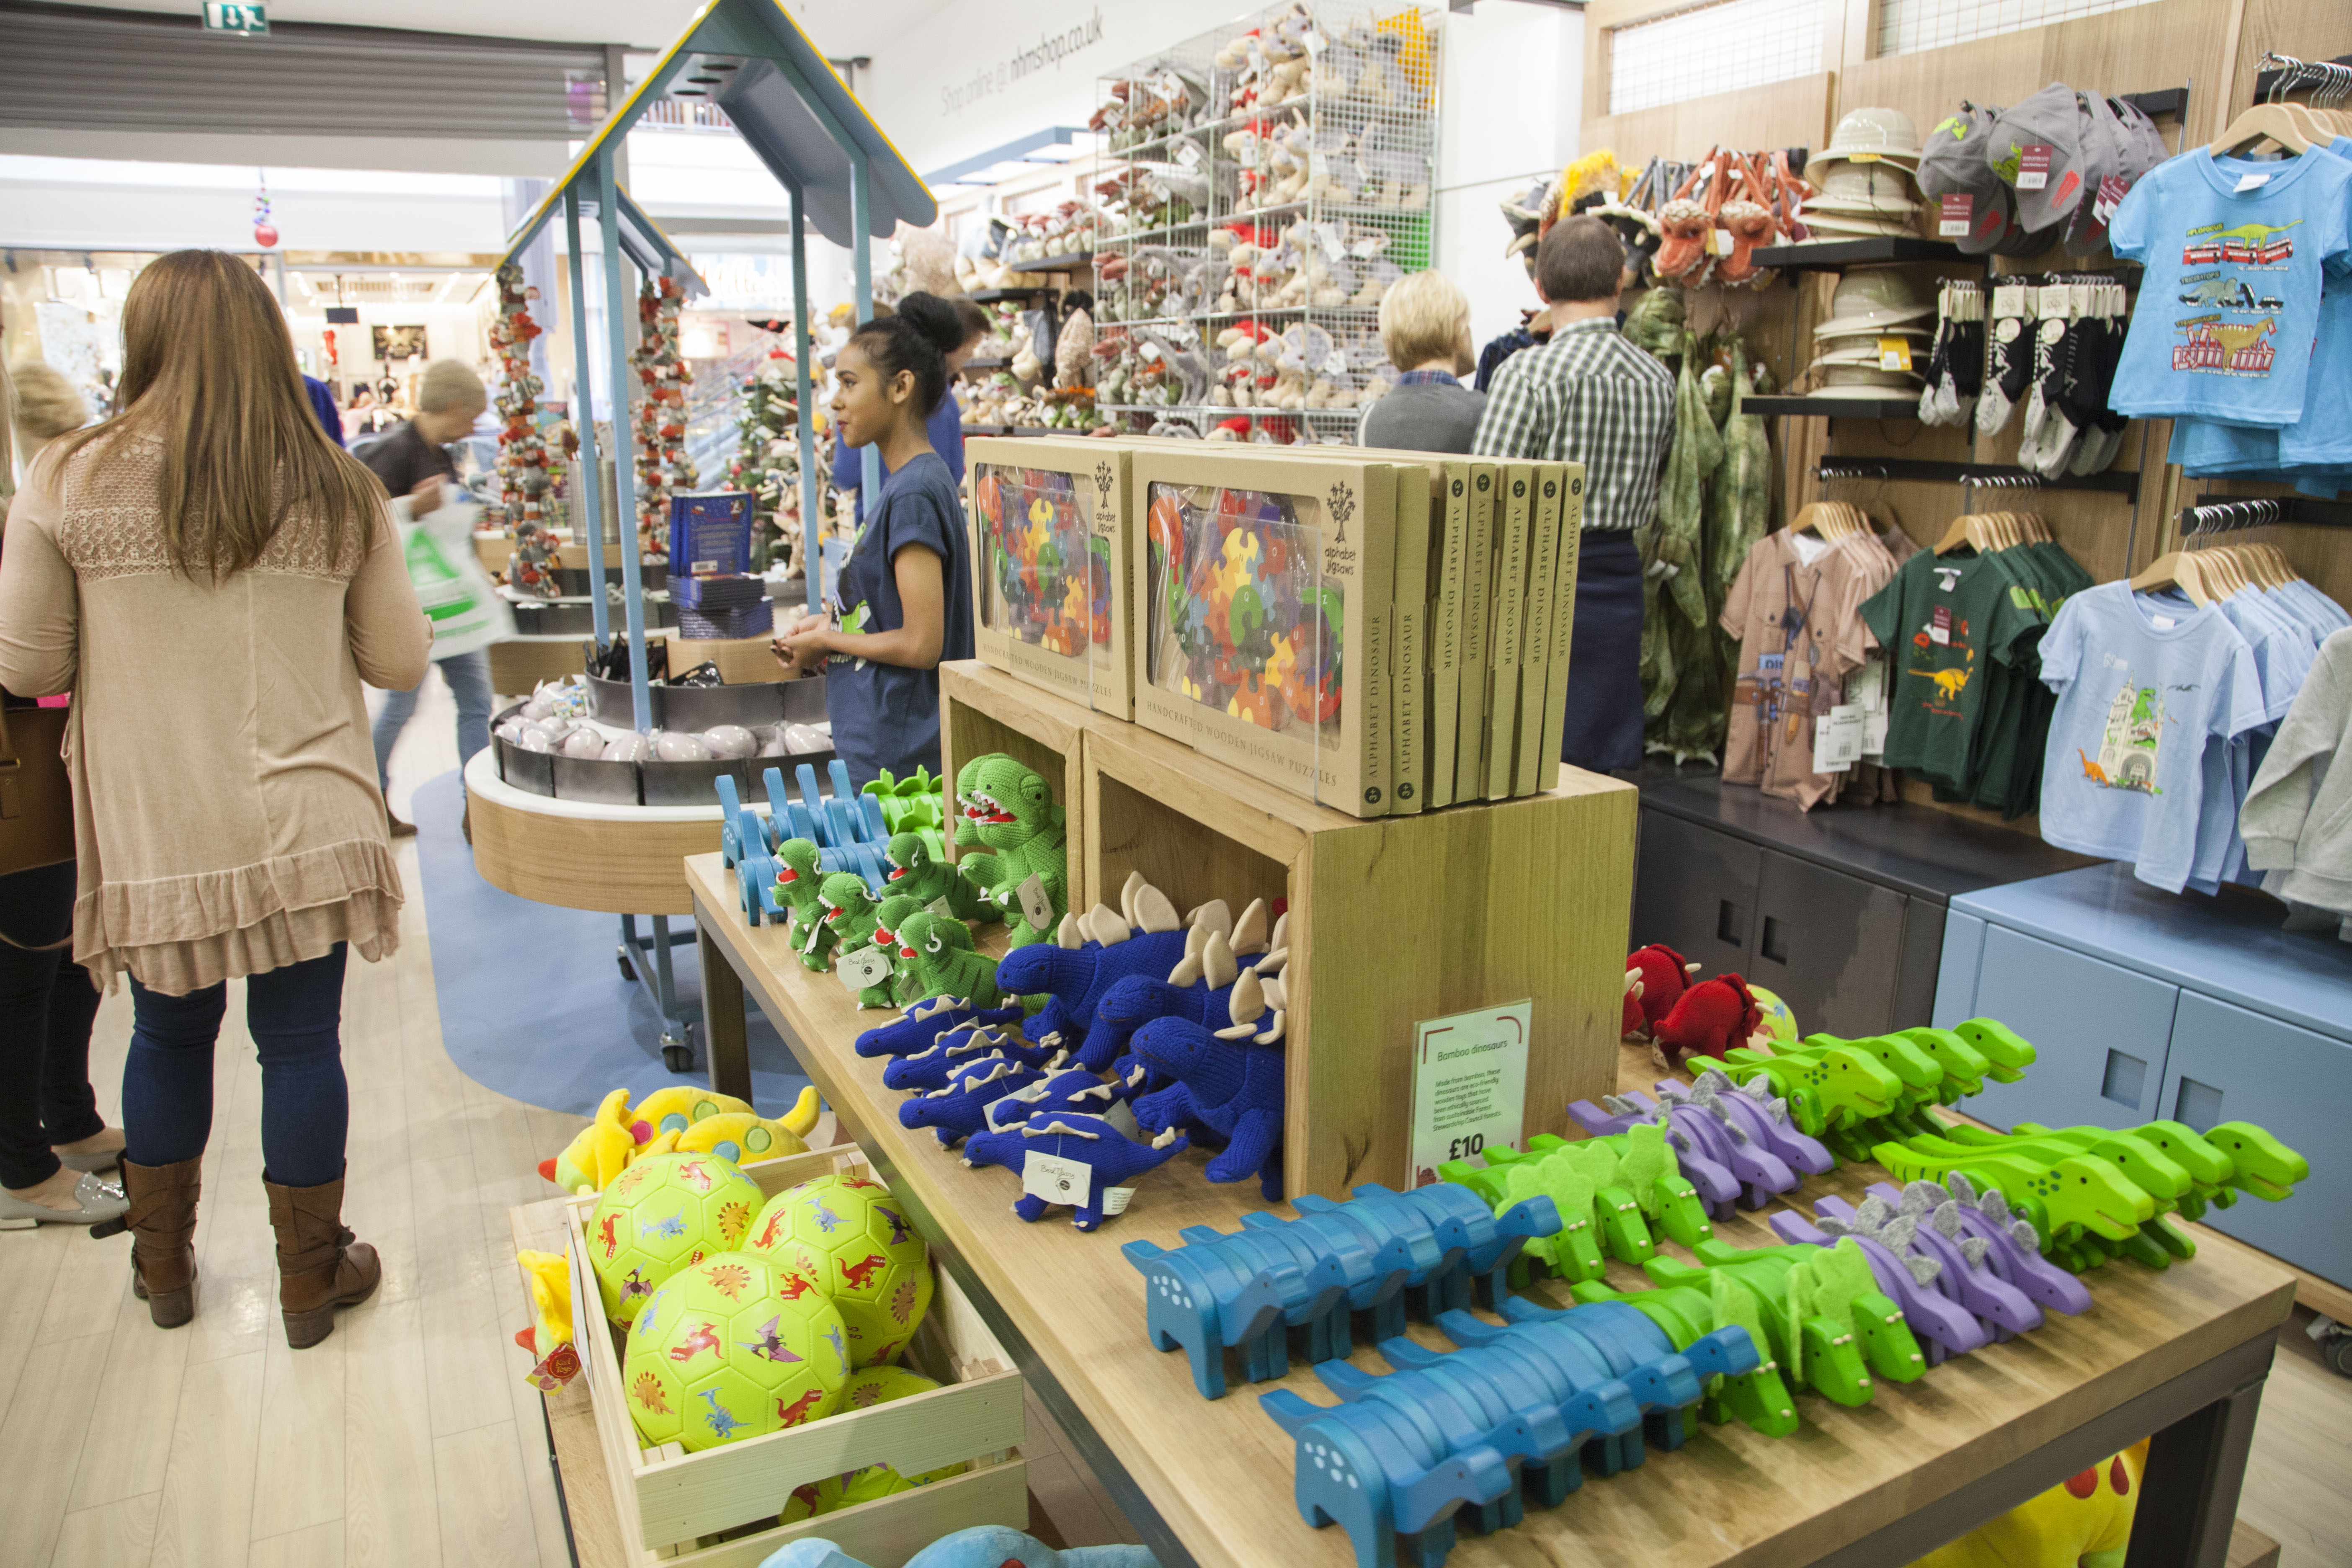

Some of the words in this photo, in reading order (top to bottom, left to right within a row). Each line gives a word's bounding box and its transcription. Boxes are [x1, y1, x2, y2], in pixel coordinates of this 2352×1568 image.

[997, 62, 1008, 92] @
[1011, 4, 1103, 82] nhmshop.co.uk
[1246, 492, 1252, 500] M
[1224, 503, 1227, 512] L
[1096, 512, 1116, 526] alphabet
[1097, 521, 1115, 534] jigsaws
[1449, 506, 1460, 584] ALPHABET
[1474, 500, 1485, 576] ALPHABET
[1509, 506, 1522, 582] ALPHABET
[1538, 507, 1552, 581] ALPHABET
[1565, 503, 1577, 576] ALPHABET
[1172, 555, 1175, 565] B
[1324, 545, 1357, 561] alphabet
[1326, 560, 1355, 575] jigsaws
[1244, 592, 1249, 602] Q
[1322, 595, 1327, 604] Z
[1444, 590, 1455, 669] DINOSAUR
[1469, 583, 1481, 661] DINOSAUR
[1504, 588, 1516, 666] DINOSAUR
[1532, 587, 1545, 664] DINOSAUR
[1558, 583, 1571, 657] DINOSAUR
[1181, 633, 1186, 643] D
[1263, 630, 1268, 640] T
[1293, 631, 1298, 640] U
[1206, 645, 1210, 654] F
[1370, 615, 1380, 696] DINOSAUR
[1402, 613, 1413, 692] DINOSAUR
[1223, 663, 1227, 672] H
[1256, 657, 1260, 667] R
[1025, 660, 1052, 675] WOODEN
[1055, 669, 1078, 686] JIGSAW
[1146, 701, 1203, 732] HANDCRAFTED
[1206, 725, 1246, 751] WOODEN
[1250, 743, 1285, 766] JIGSAW
[1289, 759, 1337, 787] PUZZLES
[1369, 703, 1378, 777] ALPHABET
[1402, 700, 1411, 774] ALPHABET
[1437, 1048, 1469, 1062] Bamboo
[1471, 1040, 1508, 1054] dinosaurs
[1435, 1086, 1459, 1096] dinosaurs
[1470, 1077, 1499, 1090] eco-friendly
[1436, 1077, 1450, 1087] Made
[1451, 1076, 1463, 1085] from
[1486, 1068, 1501, 1076] these
[1434, 1096, 1455, 1105] wooden
[1456, 1093, 1467, 1102] toys
[1479, 1088, 1491, 1096] have
[1434, 1105, 1446, 1114] been
[1447, 1100, 1468, 1112] ethically
[1469, 1096, 1489, 1106] sourced
[1433, 1114, 1445, 1123] from
[1446, 1107, 1475, 1121] sustainable
[1475, 1104, 1491, 1114] Forest
[1433, 1119, 1464, 1132] Stewardship
[1465, 1115, 1483, 1126] Council
[1449, 1132, 1484, 1161] £10
[1040, 1164, 1056, 1174] Best
[556, 1358, 571, 1367] Keel
